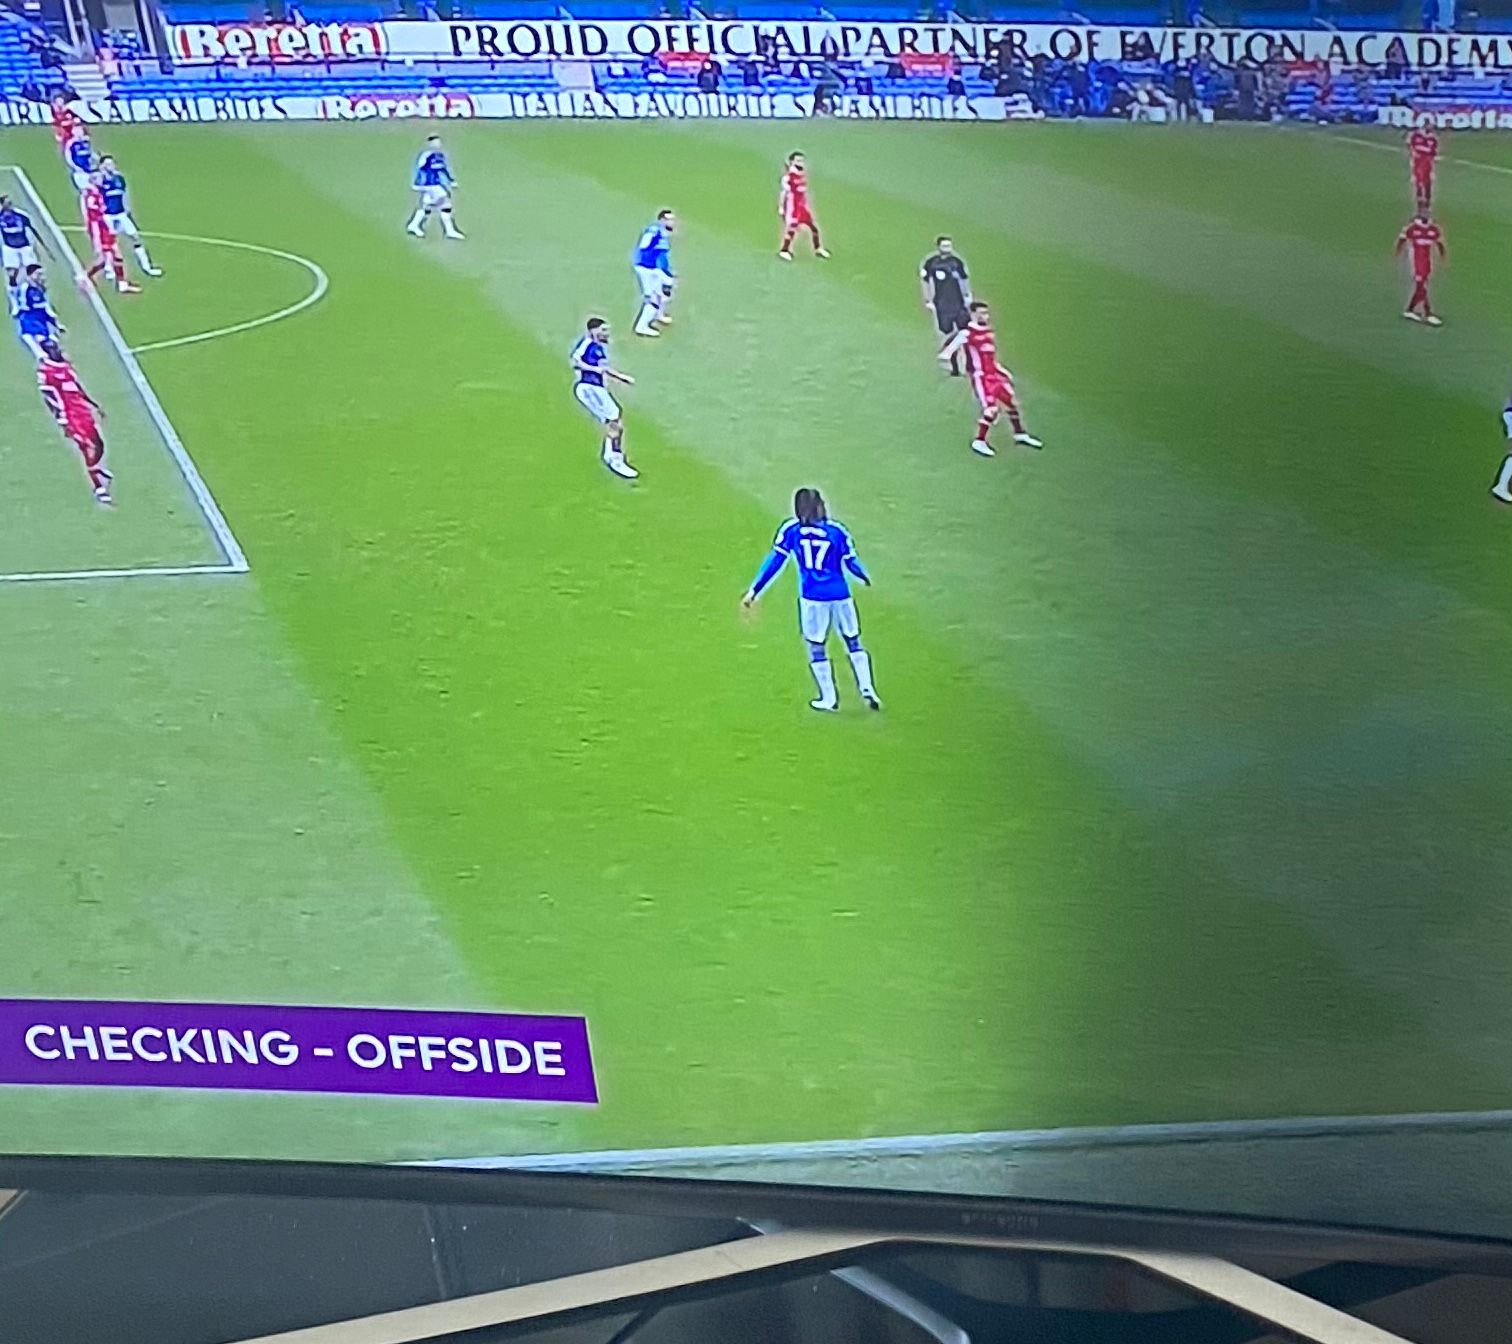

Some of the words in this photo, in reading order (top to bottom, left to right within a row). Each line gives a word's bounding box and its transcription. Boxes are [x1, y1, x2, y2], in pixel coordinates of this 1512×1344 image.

[186, 22, 375, 59] Beretta
[449, 23, 608, 57] PROUD
[627, 23, 818, 58] OFFICIAL
[840, 25, 1029, 59] PARTNER
[1049, 28, 1100, 63] OF
[1119, 29, 1306, 69] EVERTON
[799, 538, 831, 571] 17
[25, 1023, 300, 1067] CHECKING
[347, 1033, 567, 1078] OFFSIDE
